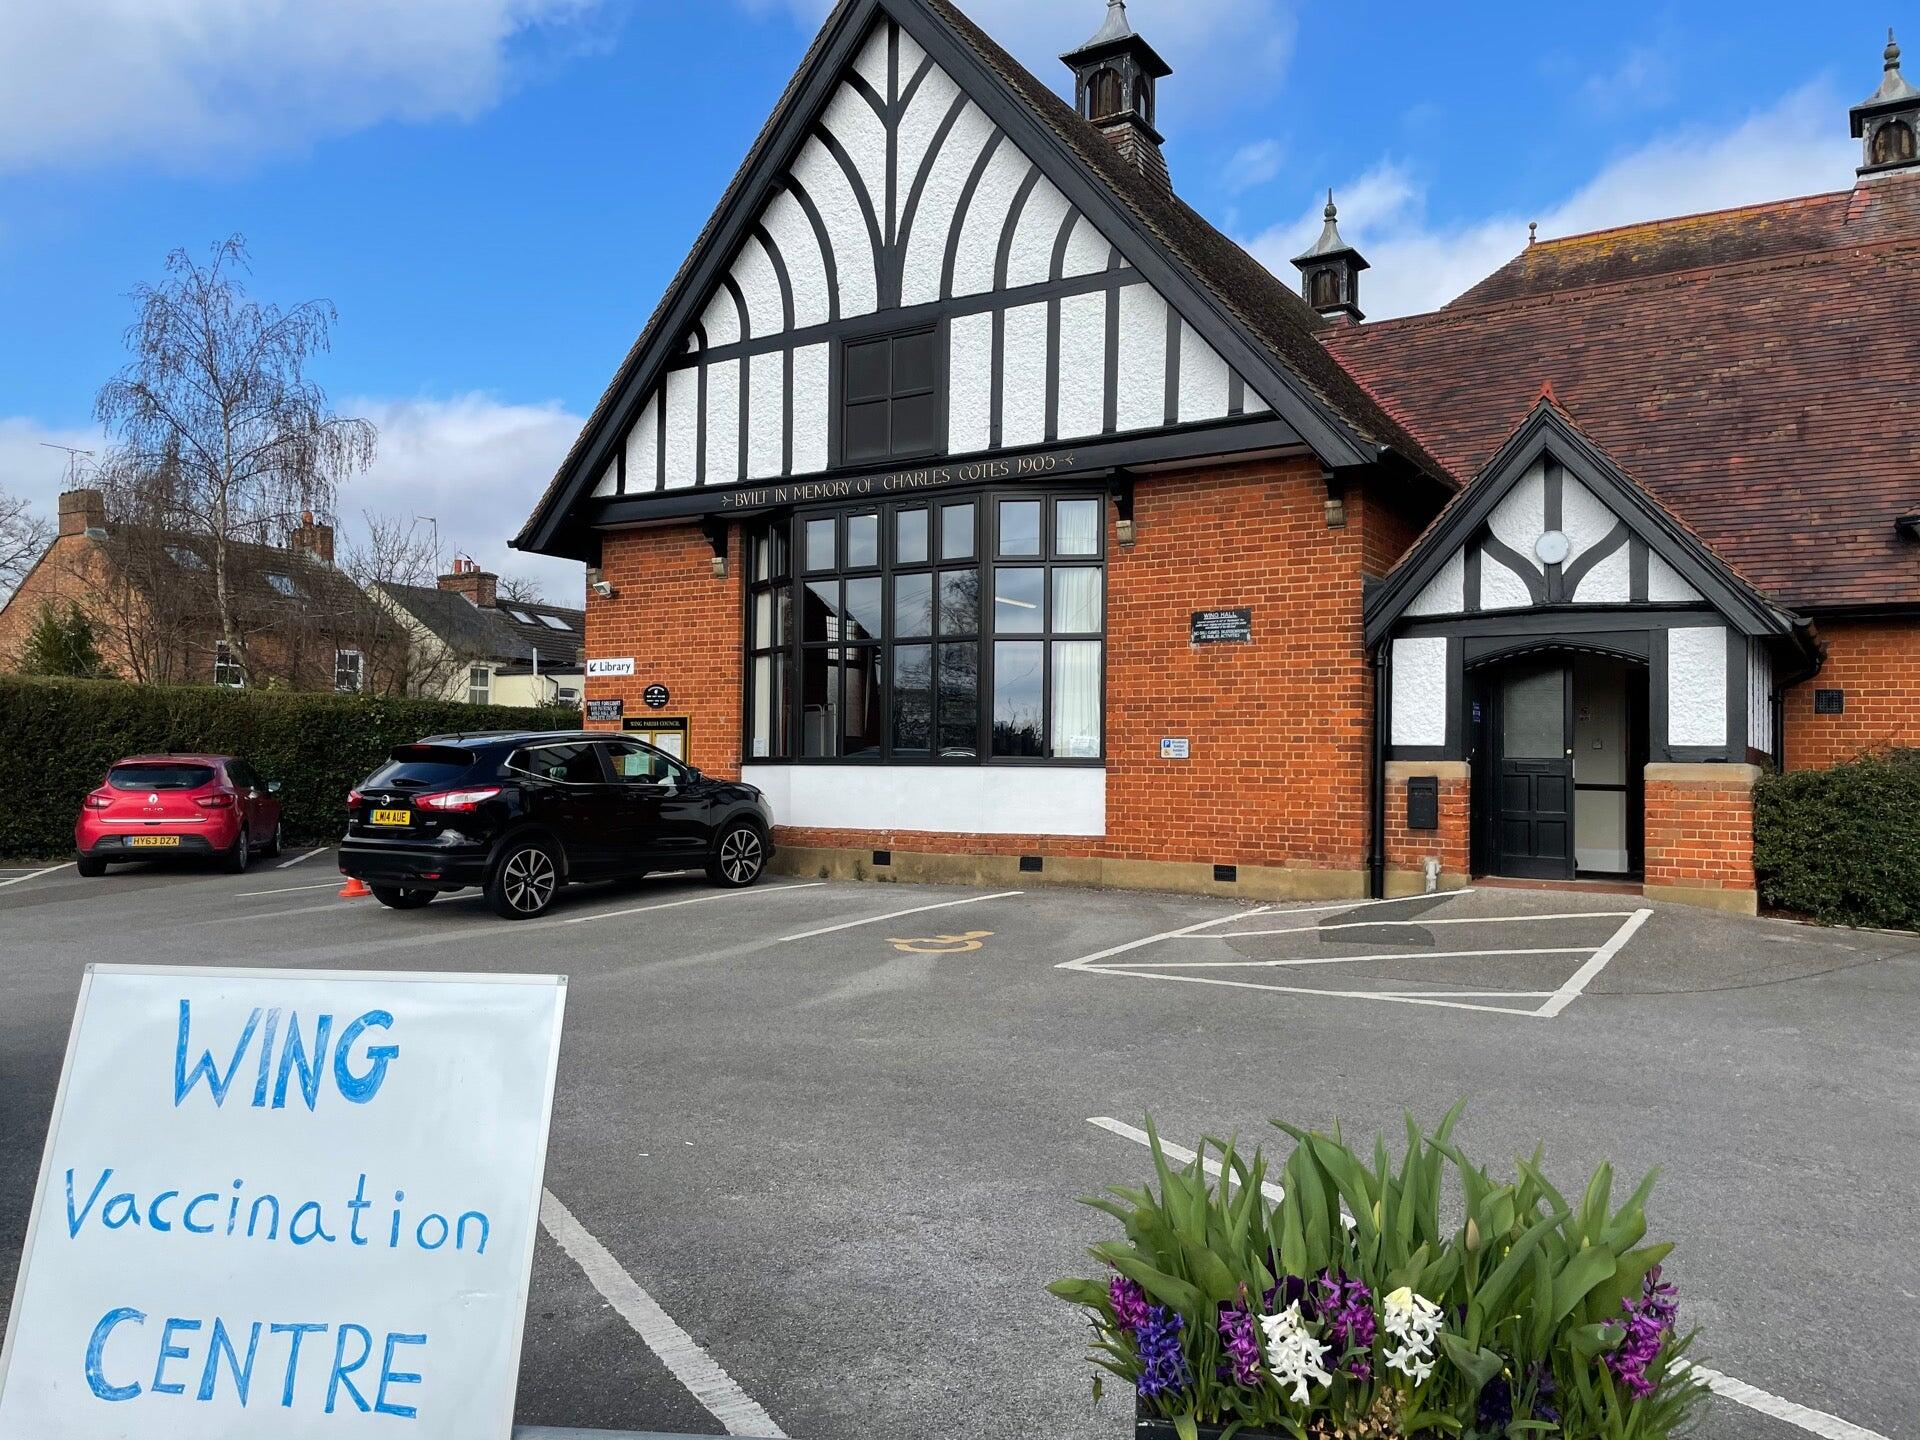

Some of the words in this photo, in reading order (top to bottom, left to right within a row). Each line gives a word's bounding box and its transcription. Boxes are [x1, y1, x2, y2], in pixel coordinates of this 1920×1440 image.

[775, 488, 787, 503] IN
[793, 481, 852, 500] MEMORY
[857, 477, 877, 493] OF
[883, 469, 950, 490] CHARLES
[958, 461, 1009, 481] COTES
[1016, 455, 1056, 474] 1905
[599, 661, 631, 674] Library
[133, 837, 158, 845] HY63
[160, 837, 178, 845] DZX
[375, 811, 391, 822] LM14
[393, 811, 407, 823] AUE
[175, 999, 399, 1112] WING
[66, 1168, 490, 1254] Vaccination
[85, 1307, 427, 1419] CENTRE
